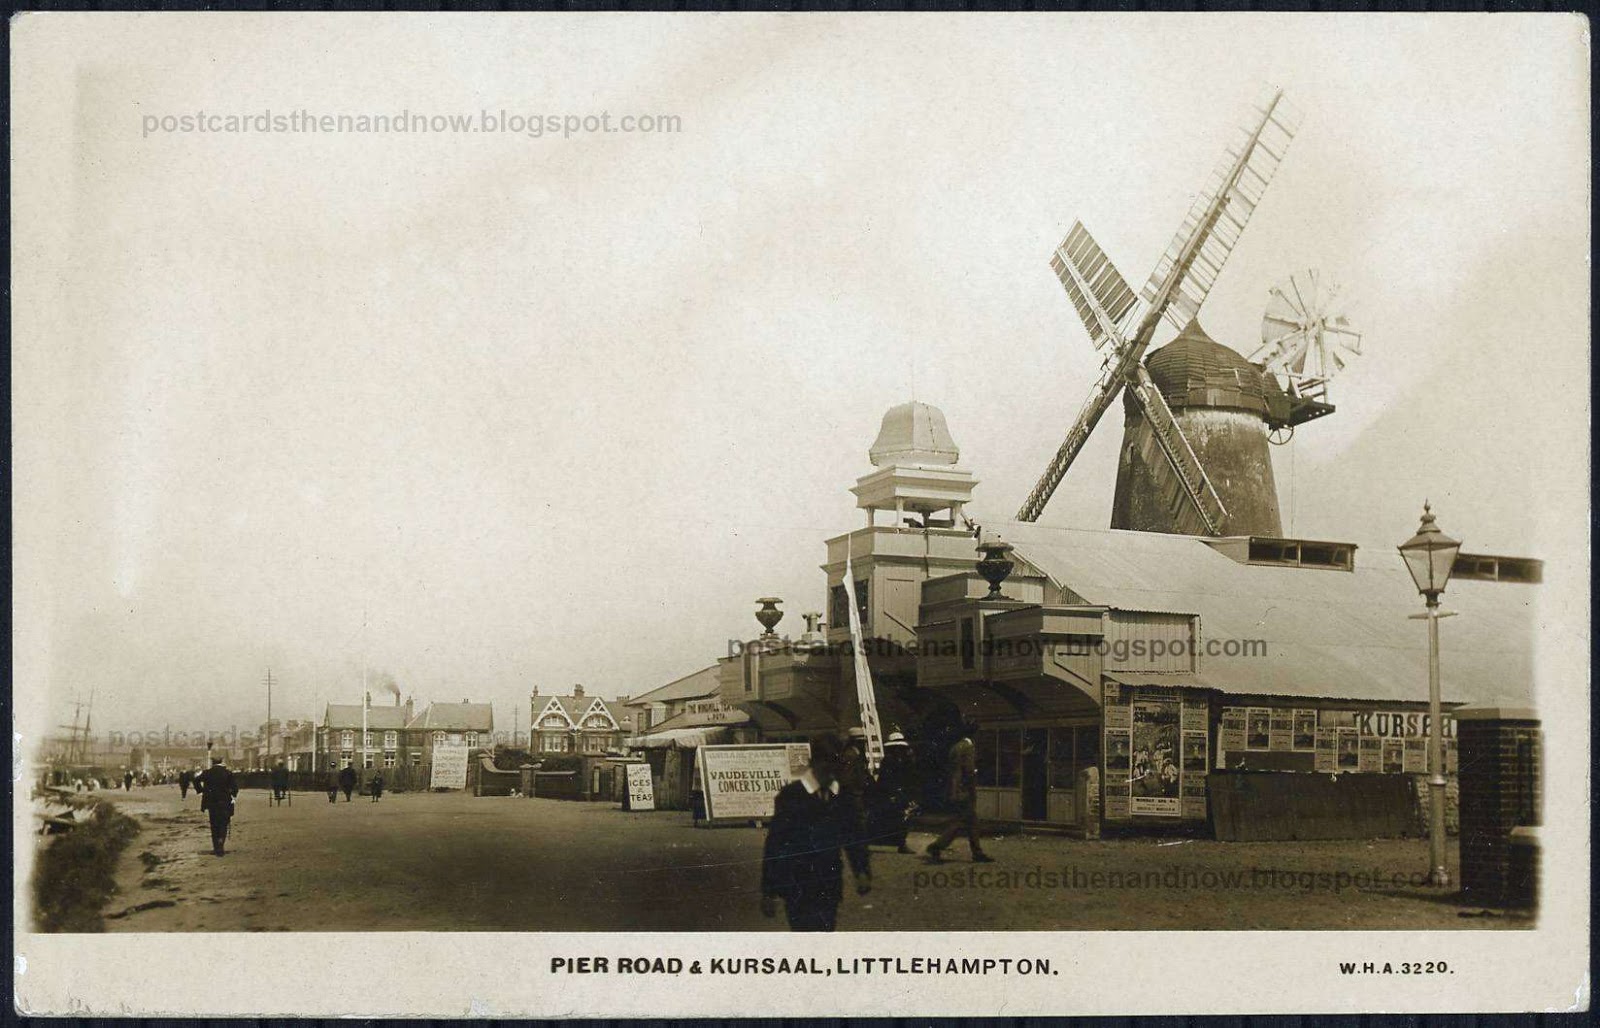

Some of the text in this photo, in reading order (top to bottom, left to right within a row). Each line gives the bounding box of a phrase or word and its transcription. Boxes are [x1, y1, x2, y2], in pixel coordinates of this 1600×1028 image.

[710, 770, 782, 781] VAUDEVILLE
[629, 778, 651, 788] ICES
[718, 780, 762, 794] CONCERTS
[630, 793, 653, 802] TEAS
